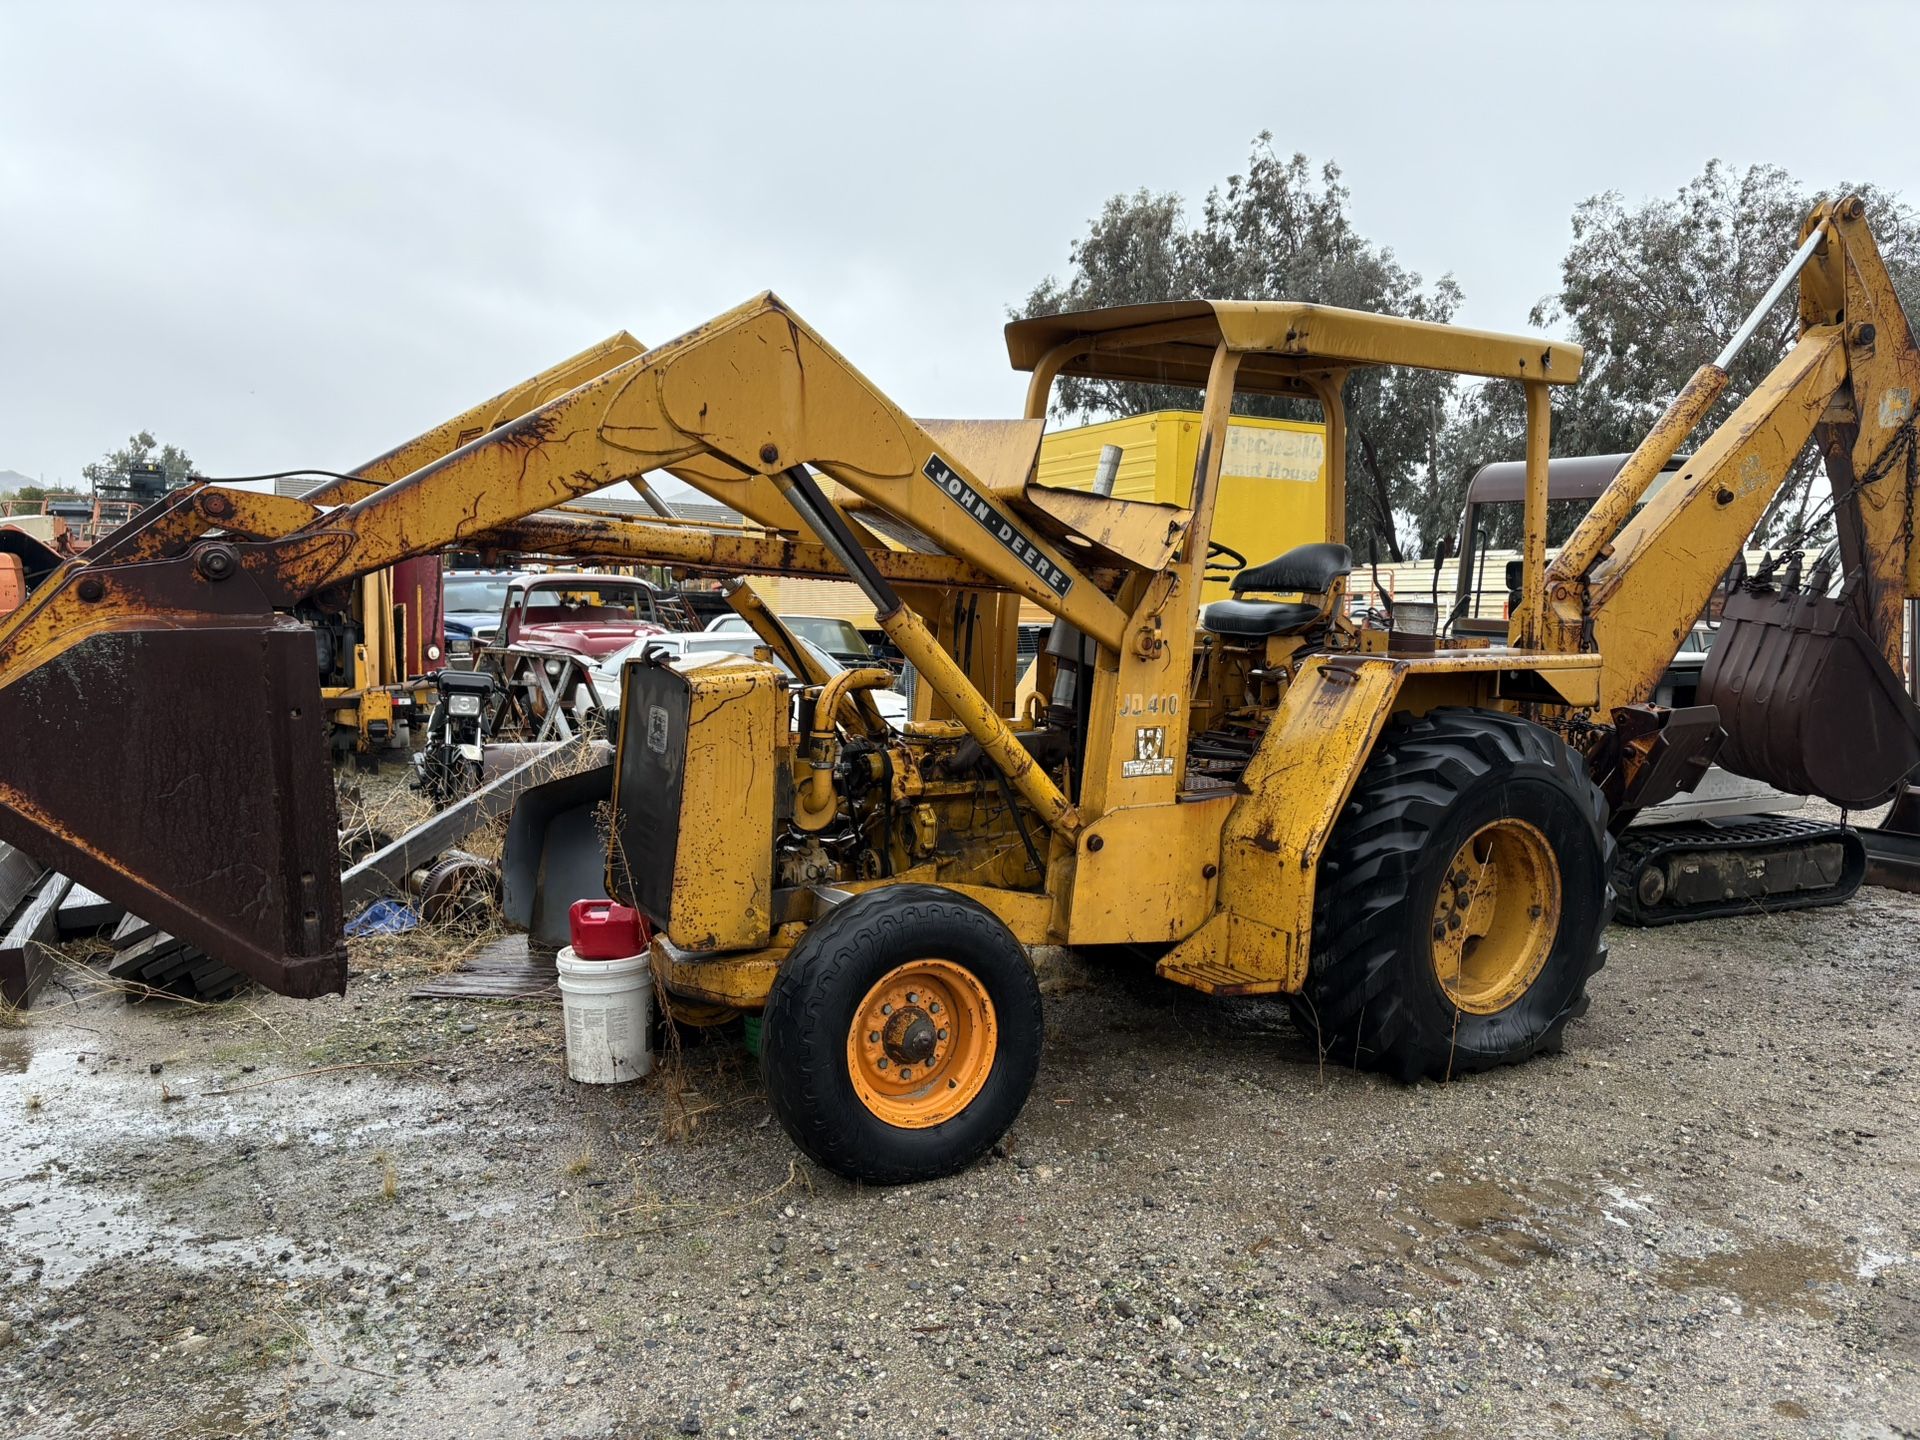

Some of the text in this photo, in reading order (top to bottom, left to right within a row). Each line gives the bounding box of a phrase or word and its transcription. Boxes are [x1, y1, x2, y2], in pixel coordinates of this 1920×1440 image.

[1266, 460, 1317, 481] House
[936, 469, 1062, 587] JOHN DEERE
[1147, 692, 1178, 716] 410
